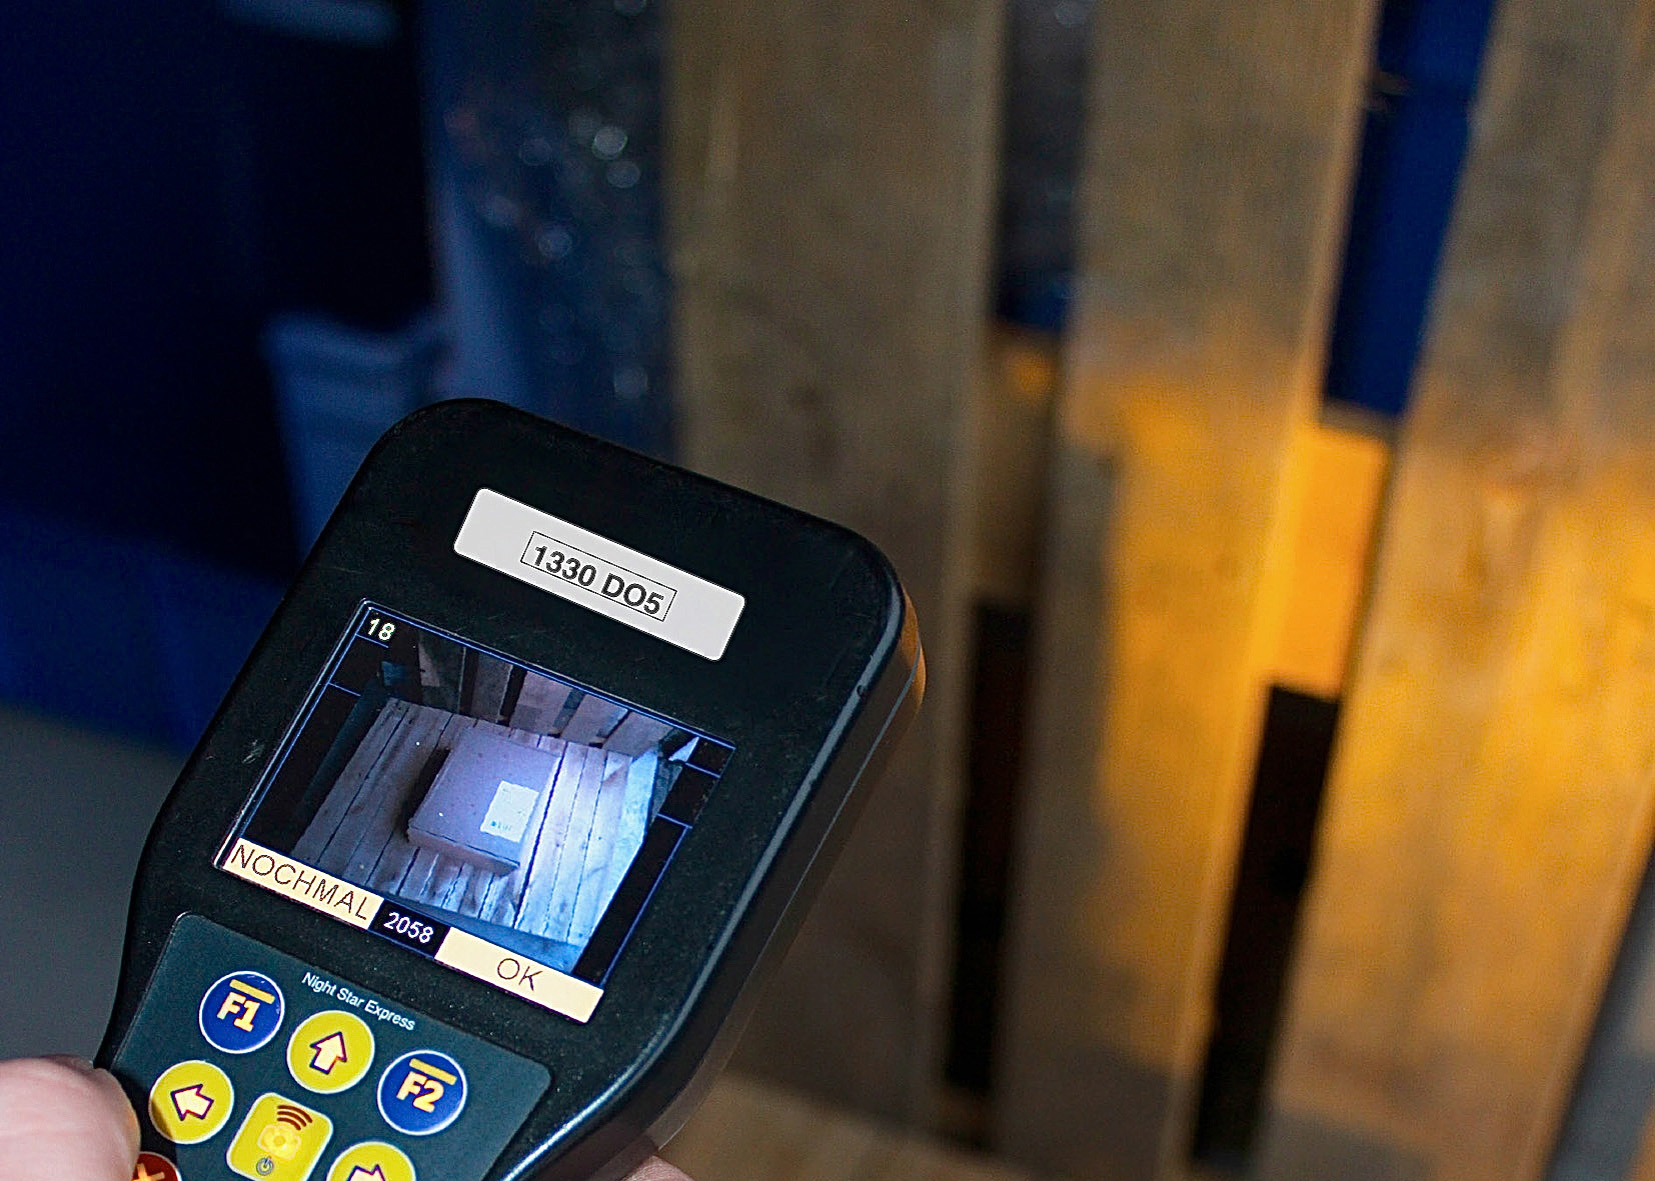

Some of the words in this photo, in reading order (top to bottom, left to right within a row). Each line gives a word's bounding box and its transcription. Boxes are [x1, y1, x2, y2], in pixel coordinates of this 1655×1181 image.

[533, 545, 597, 587] 1330
[600, 572, 664, 615] DO5
[368, 618, 396, 641] 18
[230, 844, 370, 921] NOCHMAL
[384, 911, 435, 944] 2058
[497, 957, 544, 992] OK
[217, 992, 260, 1032] F1
[301, 971, 337, 997] Night
[336, 987, 365, 1008] Star
[364, 999, 416, 1031] Express
[396, 1071, 444, 1113] F2
